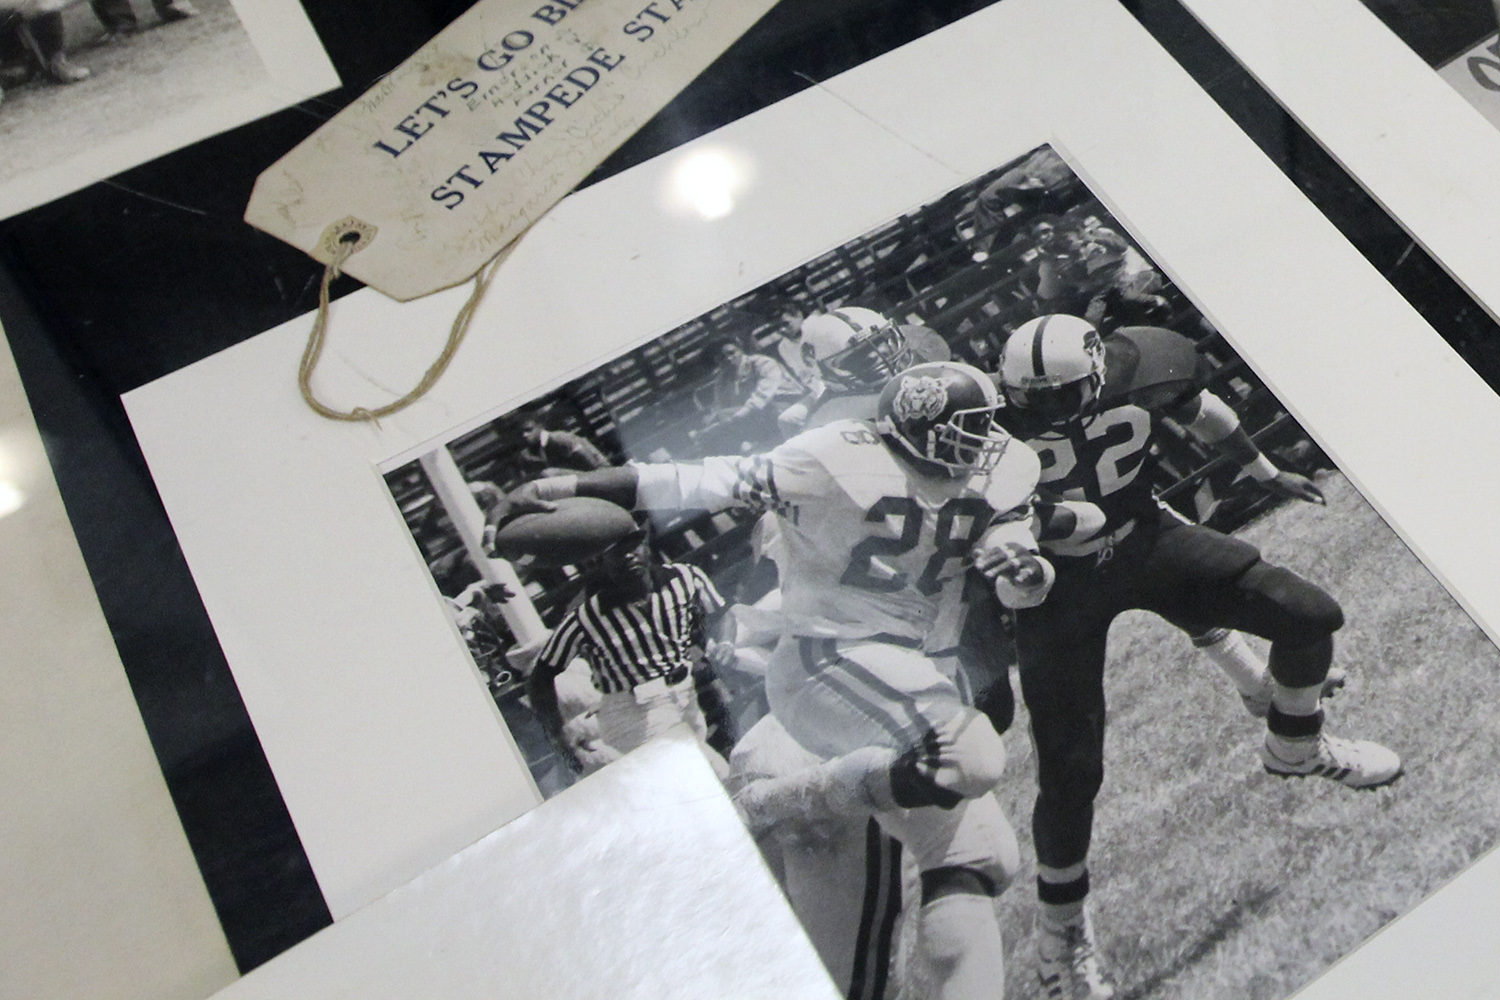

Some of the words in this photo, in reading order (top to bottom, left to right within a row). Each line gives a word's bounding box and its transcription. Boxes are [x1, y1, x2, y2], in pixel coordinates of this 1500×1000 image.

[373, 75, 479, 159] LET'S
[477, 29, 534, 73] GO
[430, 47, 626, 210] STAMPEDE
